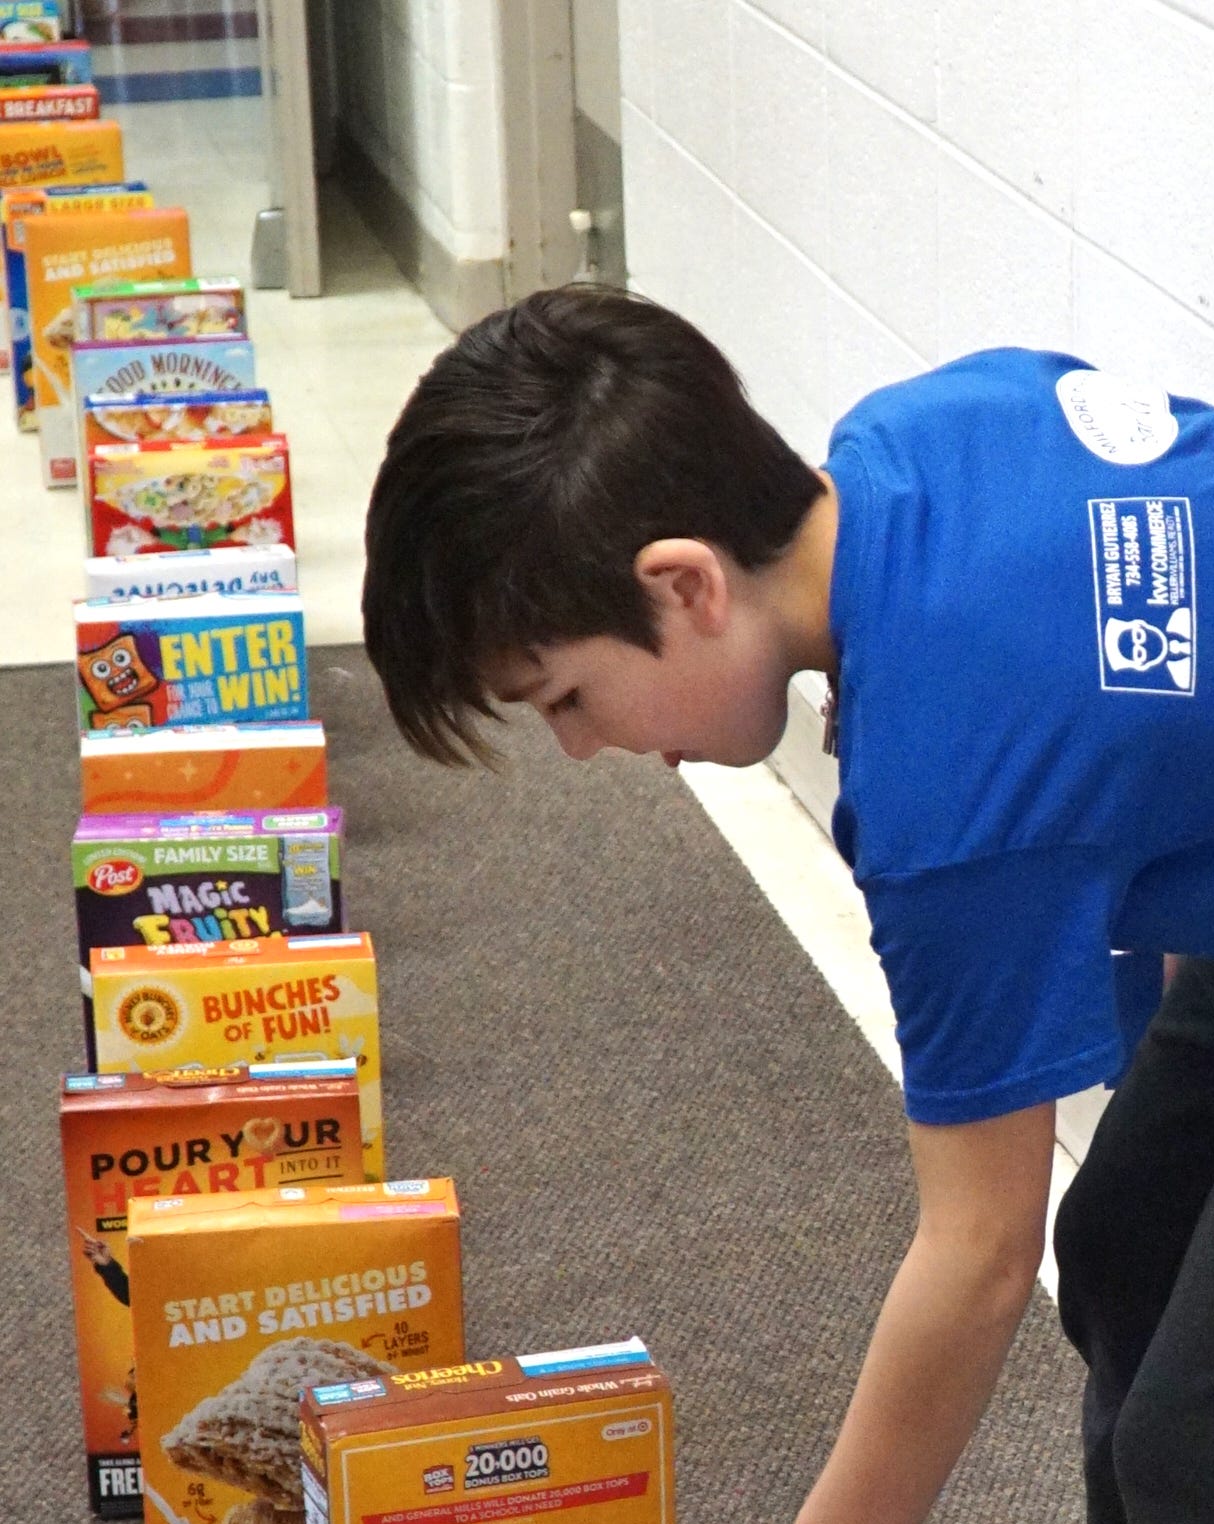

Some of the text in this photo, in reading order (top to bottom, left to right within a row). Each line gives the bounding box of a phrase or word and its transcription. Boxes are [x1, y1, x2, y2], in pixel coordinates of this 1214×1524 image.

[1100, 502, 1122, 605] BRYAN GUTIERREZ
[1146, 500, 1168, 572] COMMERCE
[159, 619, 297, 680] ENTER
[217, 666, 300, 712] WIN!
[155, 847, 222, 864] FAMILY
[227, 845, 269, 861] SIZE
[95, 864, 134, 888] Post
[202, 974, 341, 1024] BUNCHES
[224, 1007, 331, 1043] OF FUN!
[90, 1137, 211, 1181] POUR
[93, 1154, 341, 1214] HEART INTO IT
[165, 1260, 427, 1322] START DELICIOUS
[169, 1284, 432, 1347] AND SATISFIED
[384, 1331, 429, 1351] LAYERS
[390, 1360, 503, 1385] Cheerios
[542, 1383, 583, 1397] Grain
[585, 1379, 618, 1392] Whole
[506, 1391, 538, 1402] Oats
[424, 1468, 449, 1481] BOX
[465, 1475, 500, 1489] BONUS
[502, 1471, 523, 1483] BOX
[524, 1468, 549, 1480] TOPS
[381, 1513, 404, 1524] AND
[406, 1507, 451, 1521] GENERAL
[454, 1503, 482, 1514] MILLS
[483, 1499, 506, 1511] WILL
[507, 1492, 547, 1506] DONATE
[584, 1482, 603, 1493] BOX
[605, 1478, 629, 1489] TOPS
[455, 1499, 562, 1524] TO A SCHOOL IN NEED
